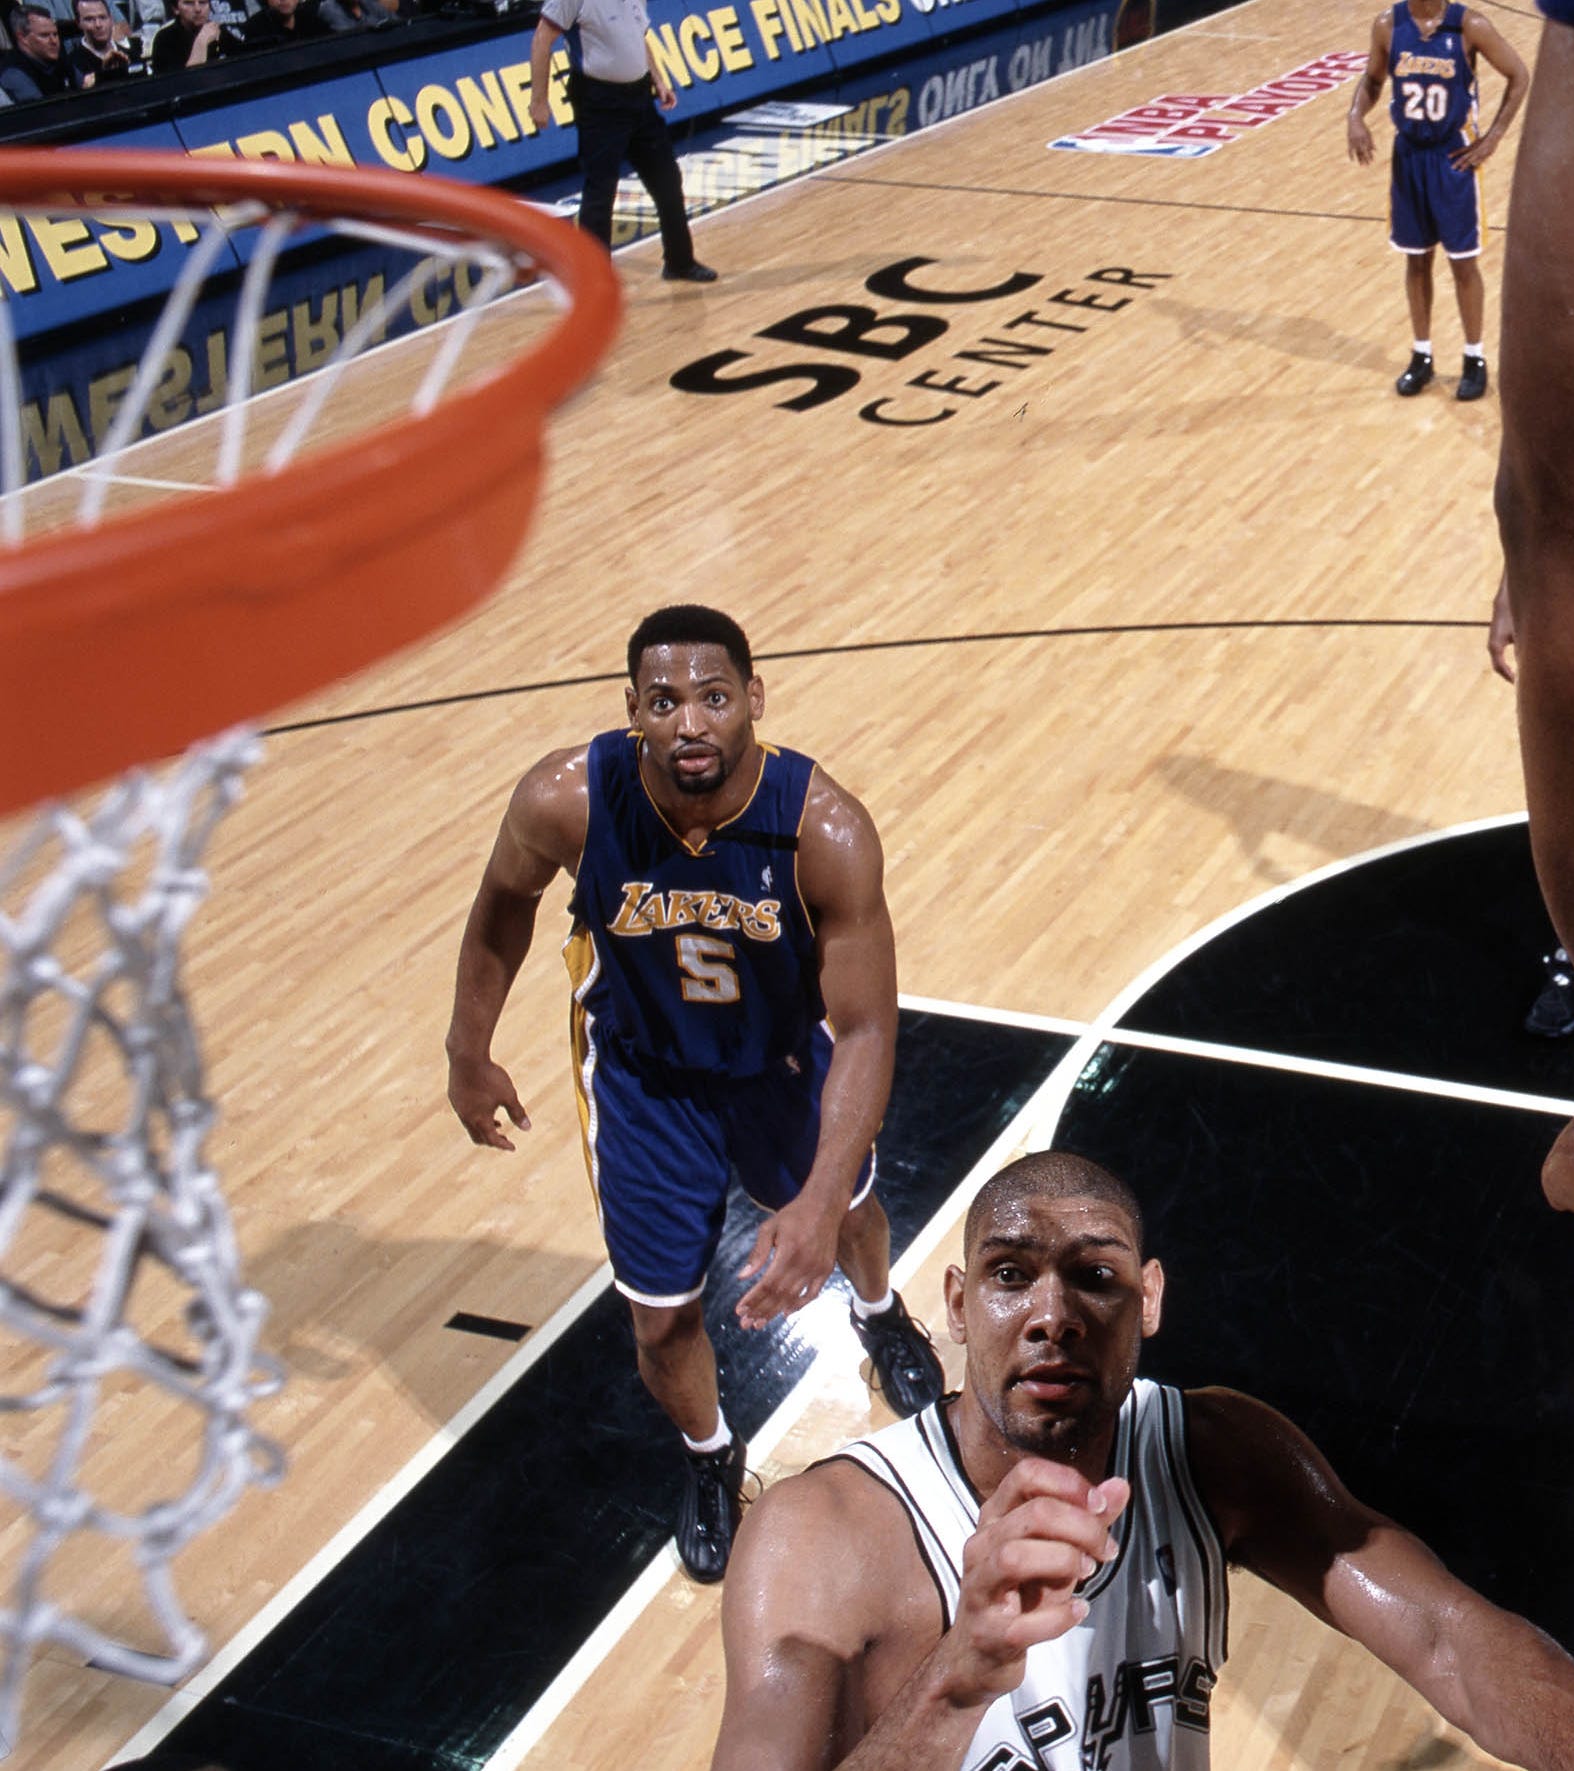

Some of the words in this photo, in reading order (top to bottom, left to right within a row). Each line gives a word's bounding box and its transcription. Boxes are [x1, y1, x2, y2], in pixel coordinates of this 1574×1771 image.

[368, 6, 753, 173] CONFENCE
[1070, 94, 1243, 143] NBA
[1154, 50, 1370, 144] PLAYOFFS
[1402, 82, 1448, 122] 20
[669, 256, 1044, 411] SBC
[858, 265, 1173, 426] CENTER
[607, 882, 781, 942] LAKERS
[675, 934, 741, 1003] 5
